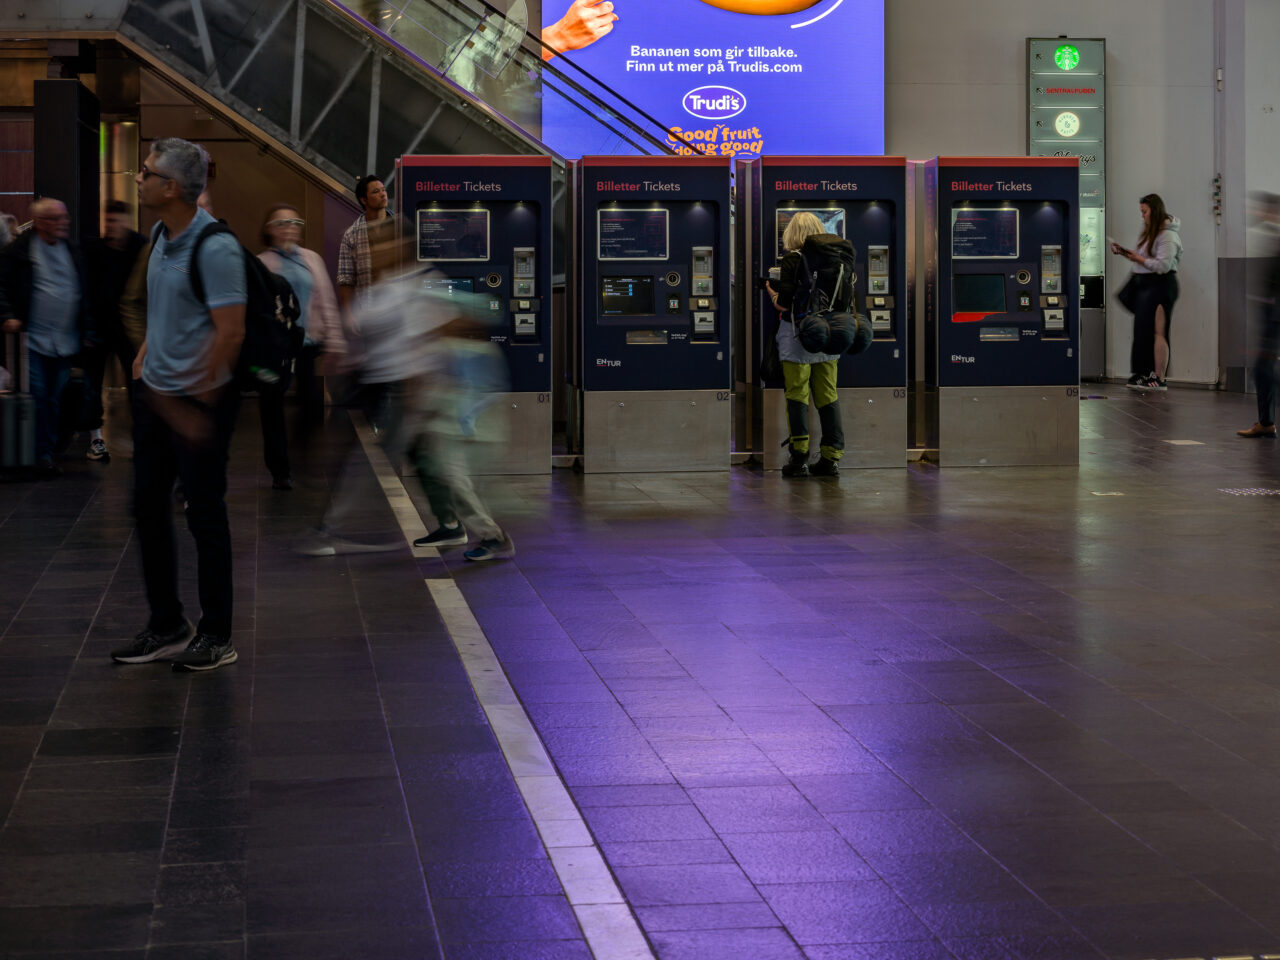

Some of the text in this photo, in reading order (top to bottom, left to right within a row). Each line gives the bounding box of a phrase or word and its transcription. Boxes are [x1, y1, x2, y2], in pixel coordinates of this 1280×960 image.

[630, 45, 798, 60] Bananen som gir tilbake.
[626, 59, 802, 74] Finn ut mer på Trudis.com
[668, 126, 762, 143] Good fruit
[720, 140, 764, 158] good
[416, 181, 501, 192] Billetter Tickets
[596, 181, 680, 192] Billetter Tickets
[775, 181, 857, 192] Billetter Tickets
[952, 181, 1032, 192] Billetter Tickets
[596, 358, 621, 368] ENTUR
[716, 392, 730, 401] 02
[893, 389, 906, 399] 03
[1066, 387, 1079, 397] 09
[538, 393, 550, 404] 01
